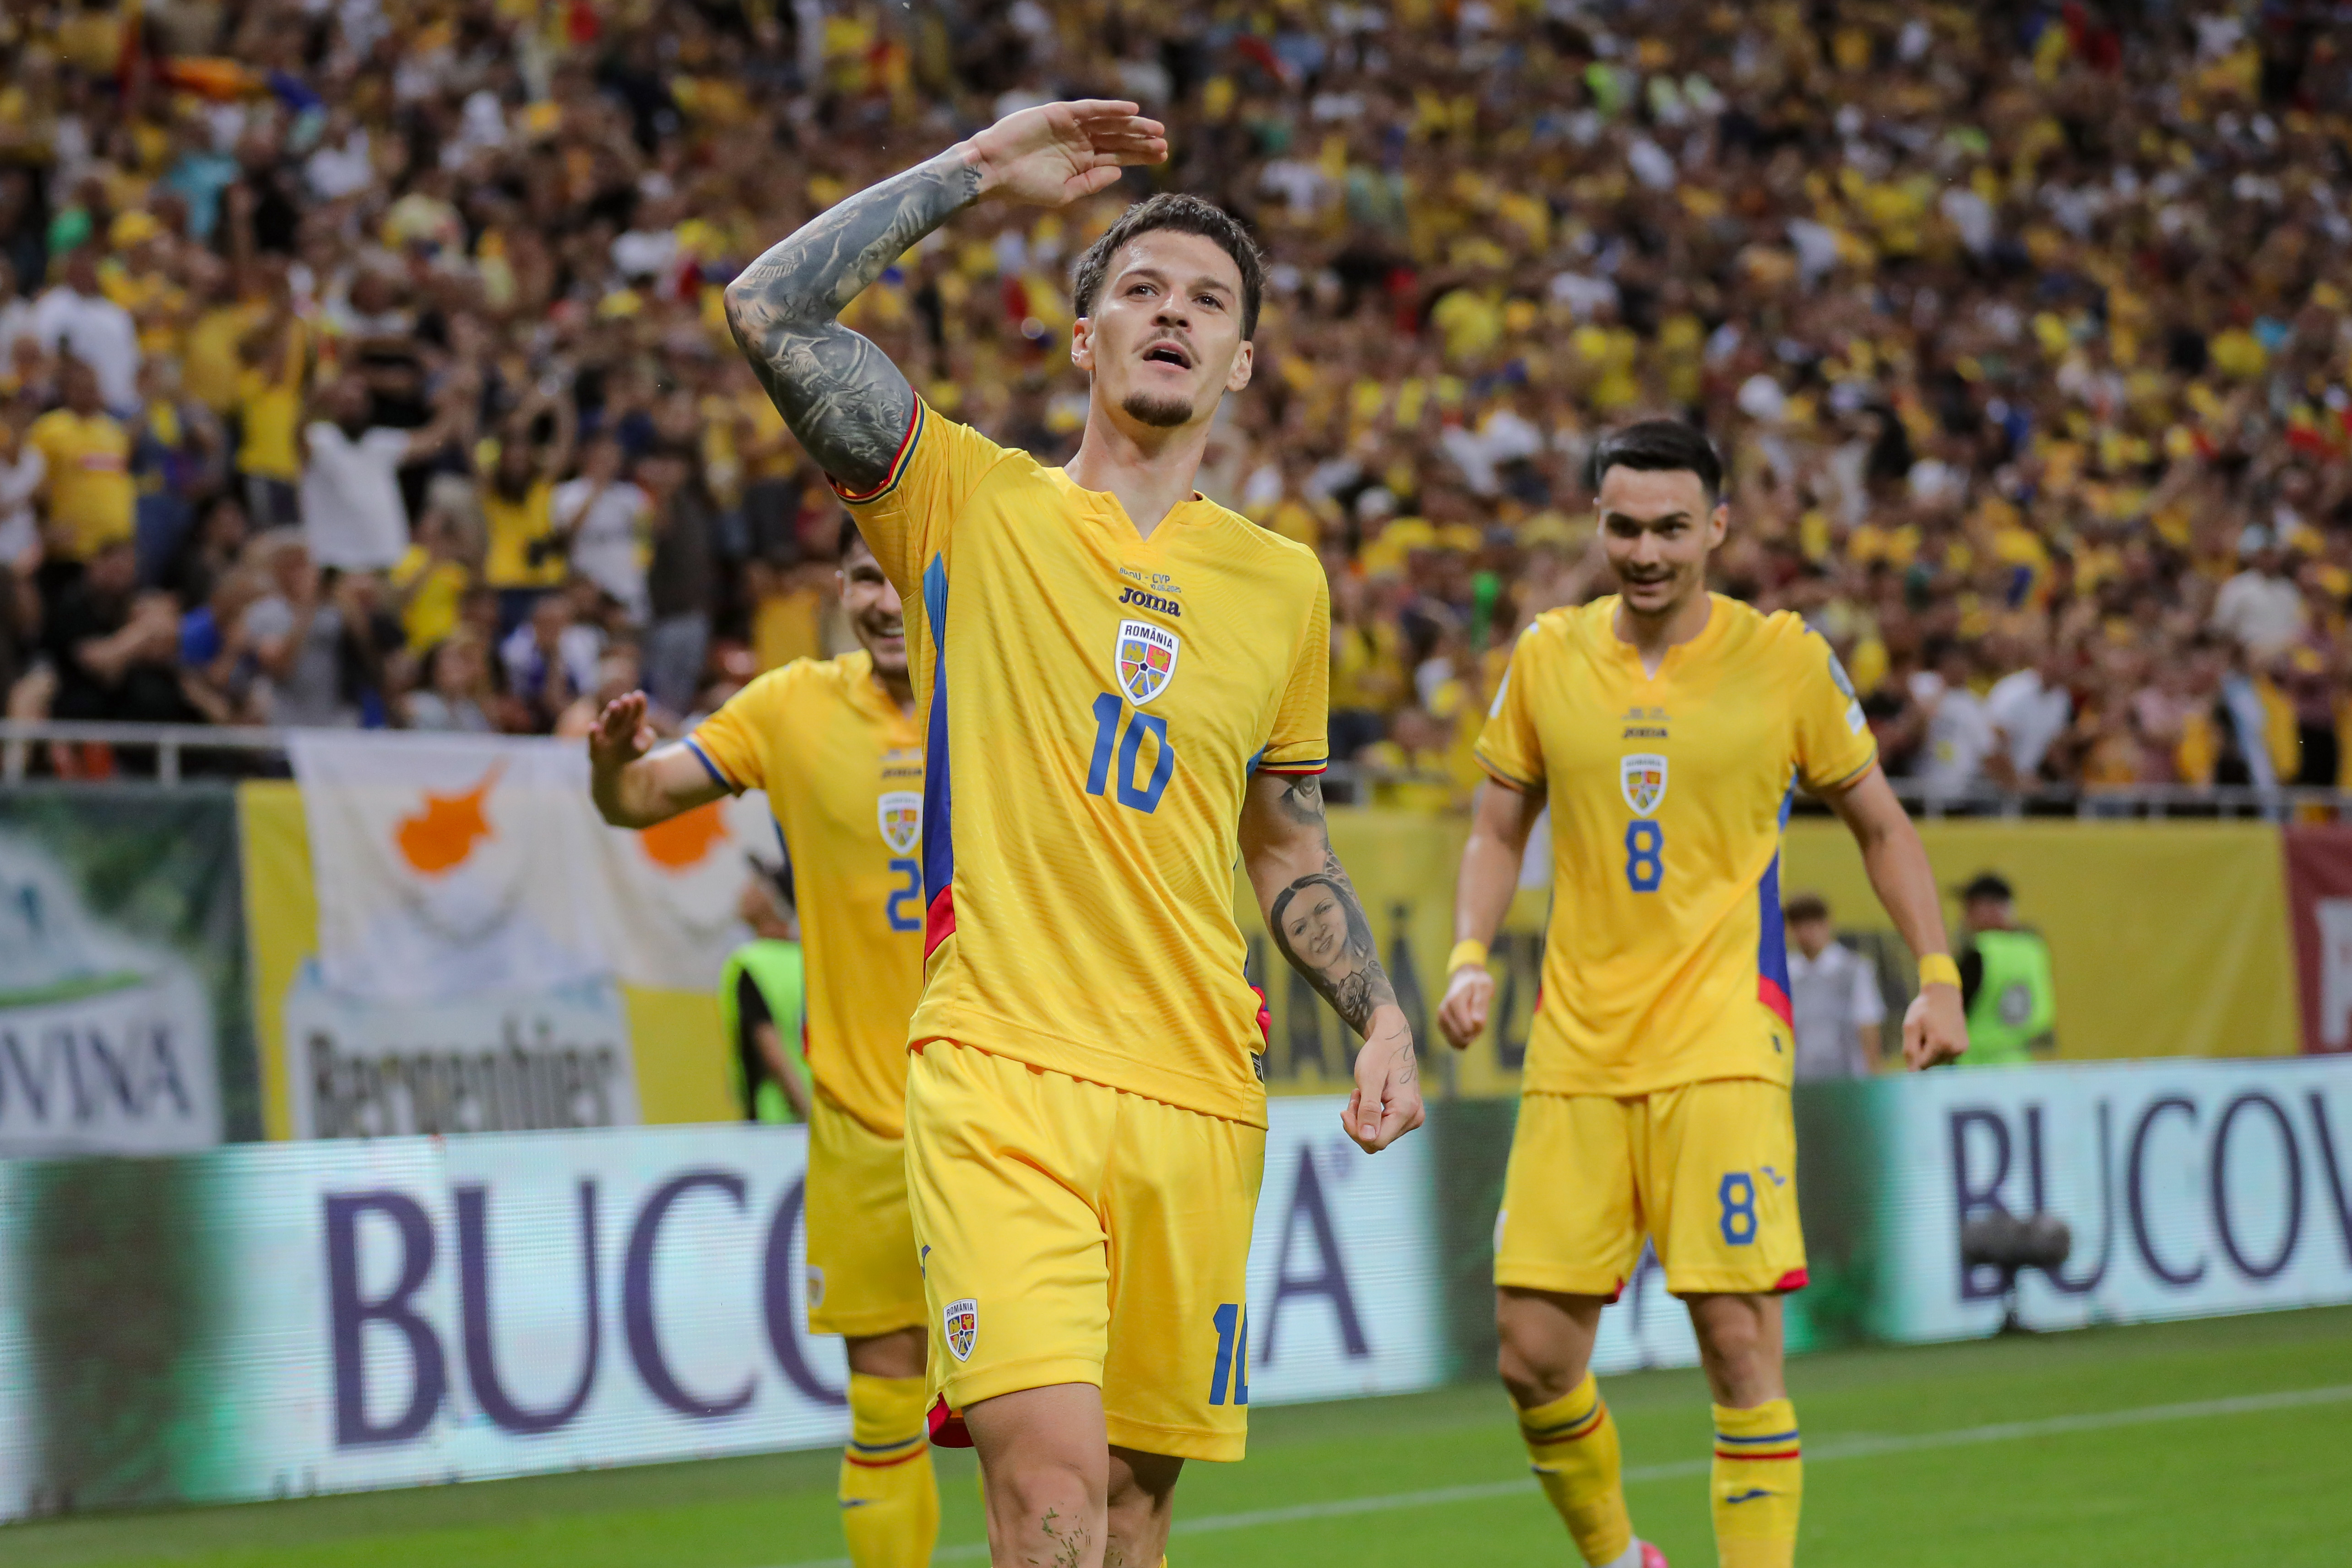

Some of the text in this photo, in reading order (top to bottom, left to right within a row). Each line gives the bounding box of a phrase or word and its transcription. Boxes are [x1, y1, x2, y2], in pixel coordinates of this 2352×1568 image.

[1152, 574, 1170, 584] CYP
[1125, 625, 1173, 649] ROMÂNIA
[1086, 692, 1174, 814] 10
[1624, 819, 1664, 892] 8
[886, 858, 922, 932] 2
[1719, 1172, 1757, 1247] 8
[946, 1302, 974, 1317] ROMÂNIA
